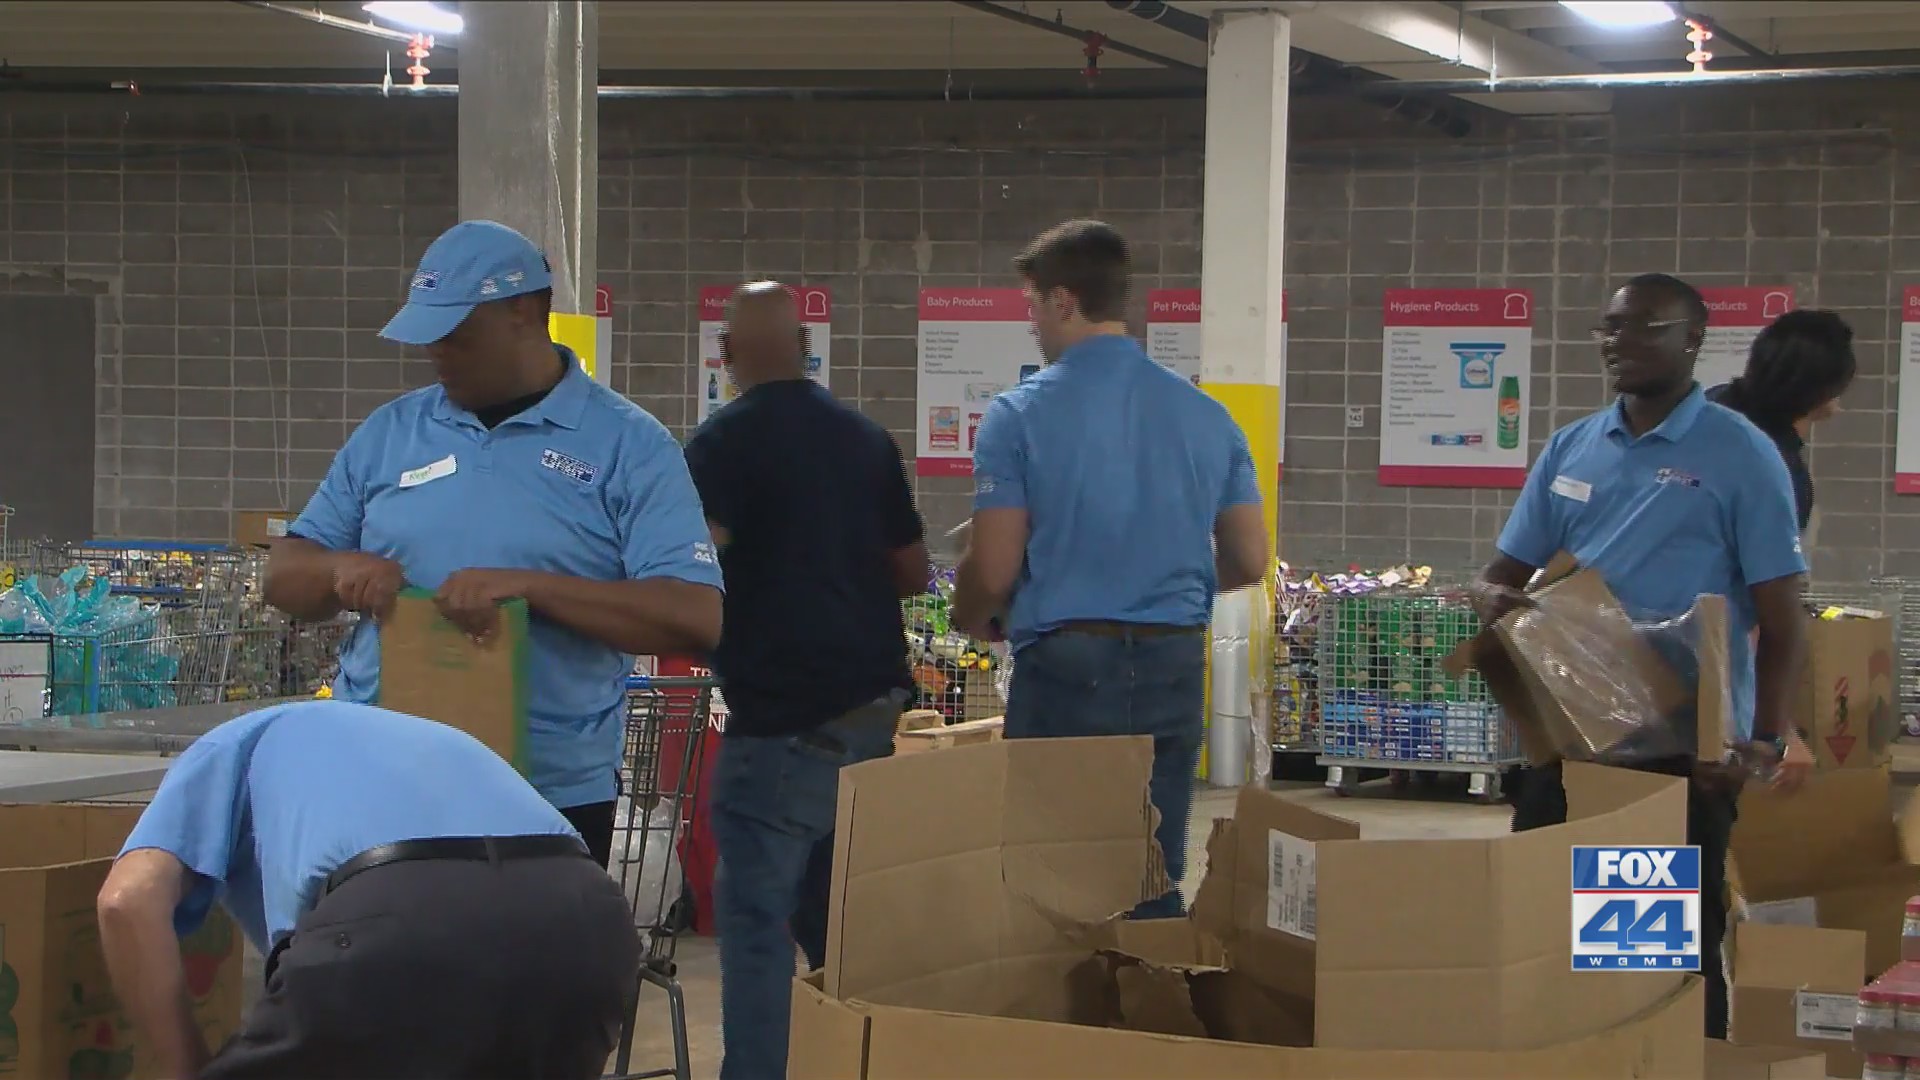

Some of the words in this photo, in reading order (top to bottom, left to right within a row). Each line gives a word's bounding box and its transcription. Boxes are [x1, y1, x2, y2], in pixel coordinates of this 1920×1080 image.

[926, 296, 950, 308] Baby
[952, 296, 994, 307] Products
[1153, 301, 1169, 312] Pet
[1171, 301, 1201, 312] Produ
[1390, 301, 1431, 314] Hygiene
[1434, 301, 1480, 312] Products
